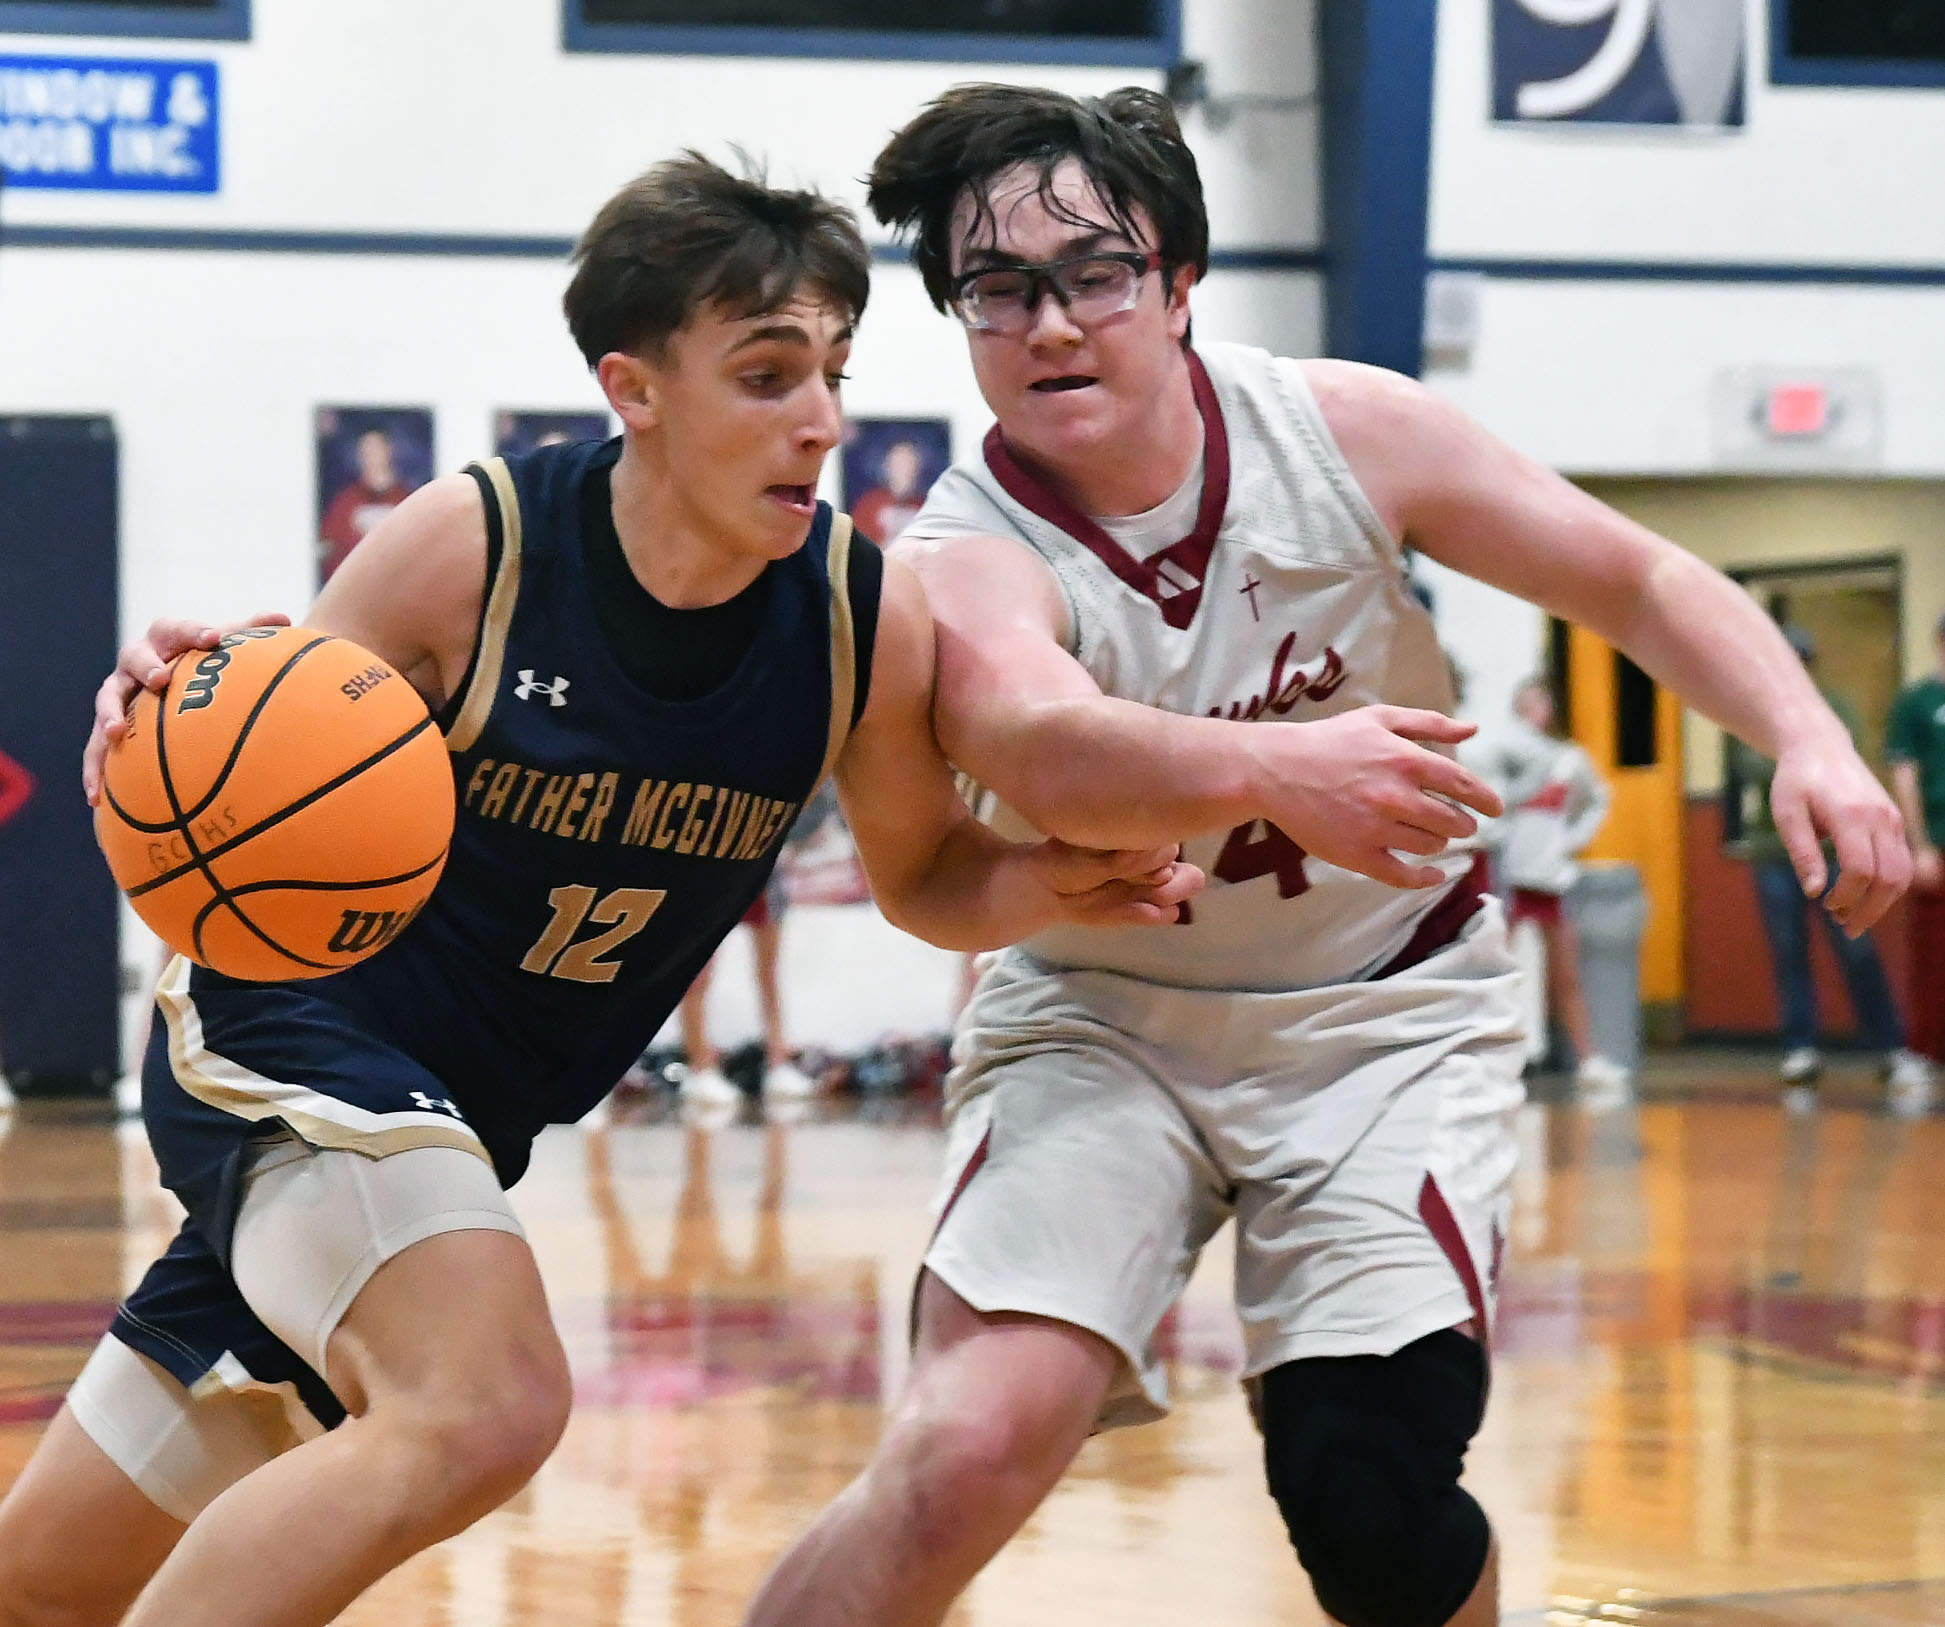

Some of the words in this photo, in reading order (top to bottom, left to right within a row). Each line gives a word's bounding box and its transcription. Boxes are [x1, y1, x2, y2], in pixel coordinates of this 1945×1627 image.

[0, 67, 155, 120] INDOW
[464, 758, 621, 843] FATHER
[519, 883, 667, 983] 12
